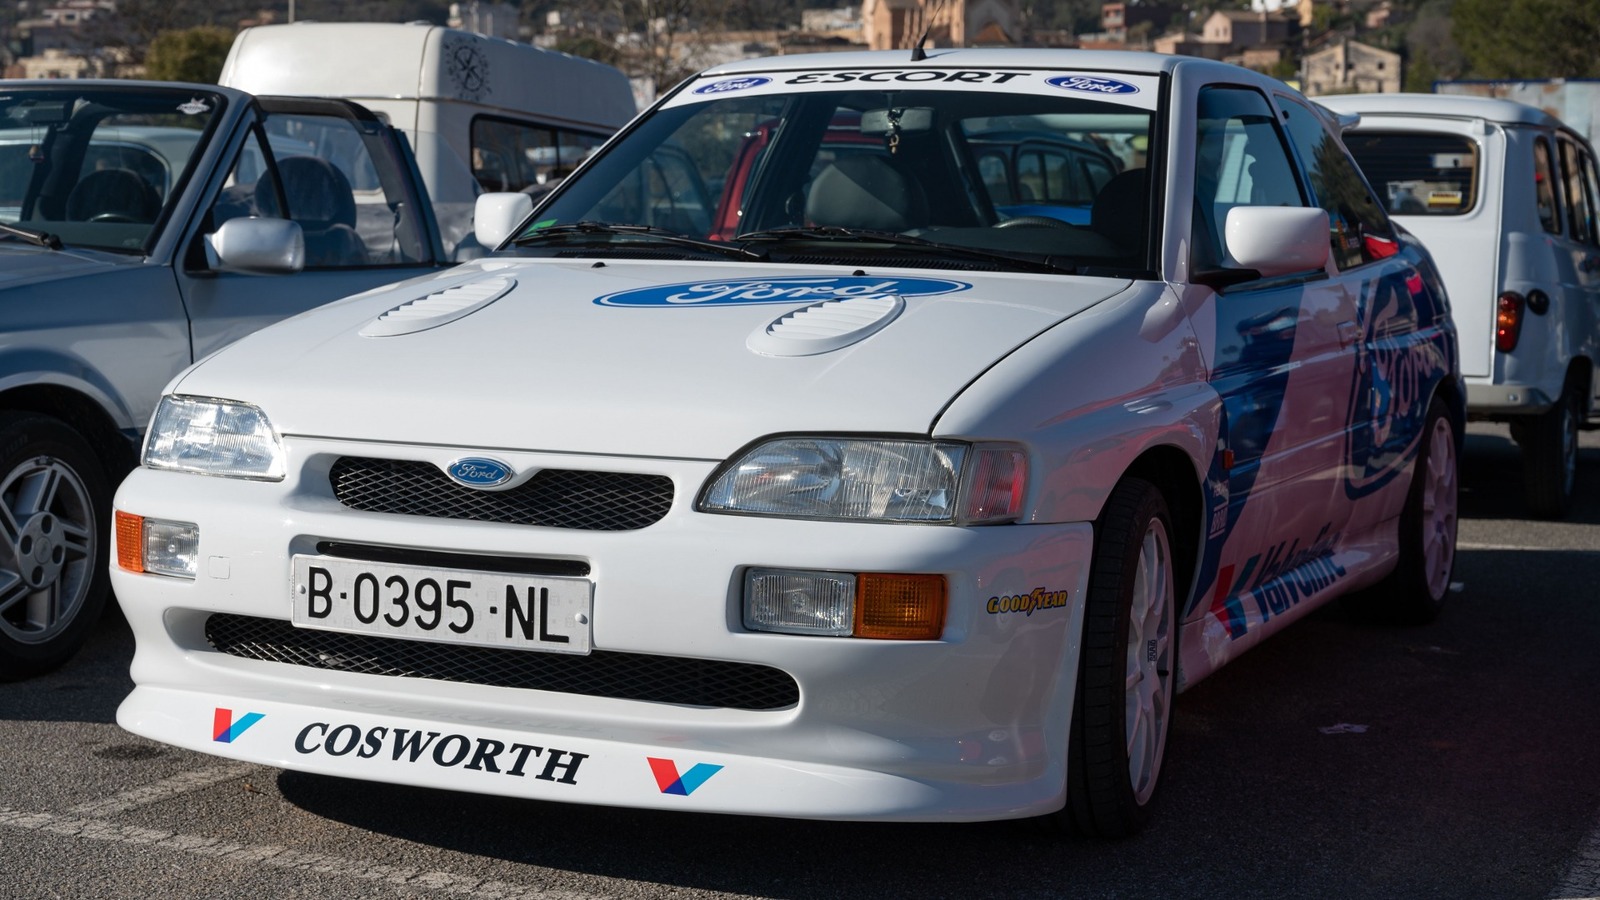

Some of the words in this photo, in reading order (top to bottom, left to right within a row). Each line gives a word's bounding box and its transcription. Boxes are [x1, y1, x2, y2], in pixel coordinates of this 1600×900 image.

[704, 78, 760, 94] Ford
[784, 70, 1032, 85] ESCORT
[1060, 77, 1124, 93] Ford
[666, 278, 899, 304] Ford
[457, 463, 499, 480] Ford
[986, 586, 1069, 617] GOODYEAR
[294, 722, 590, 786] COSWORTH
